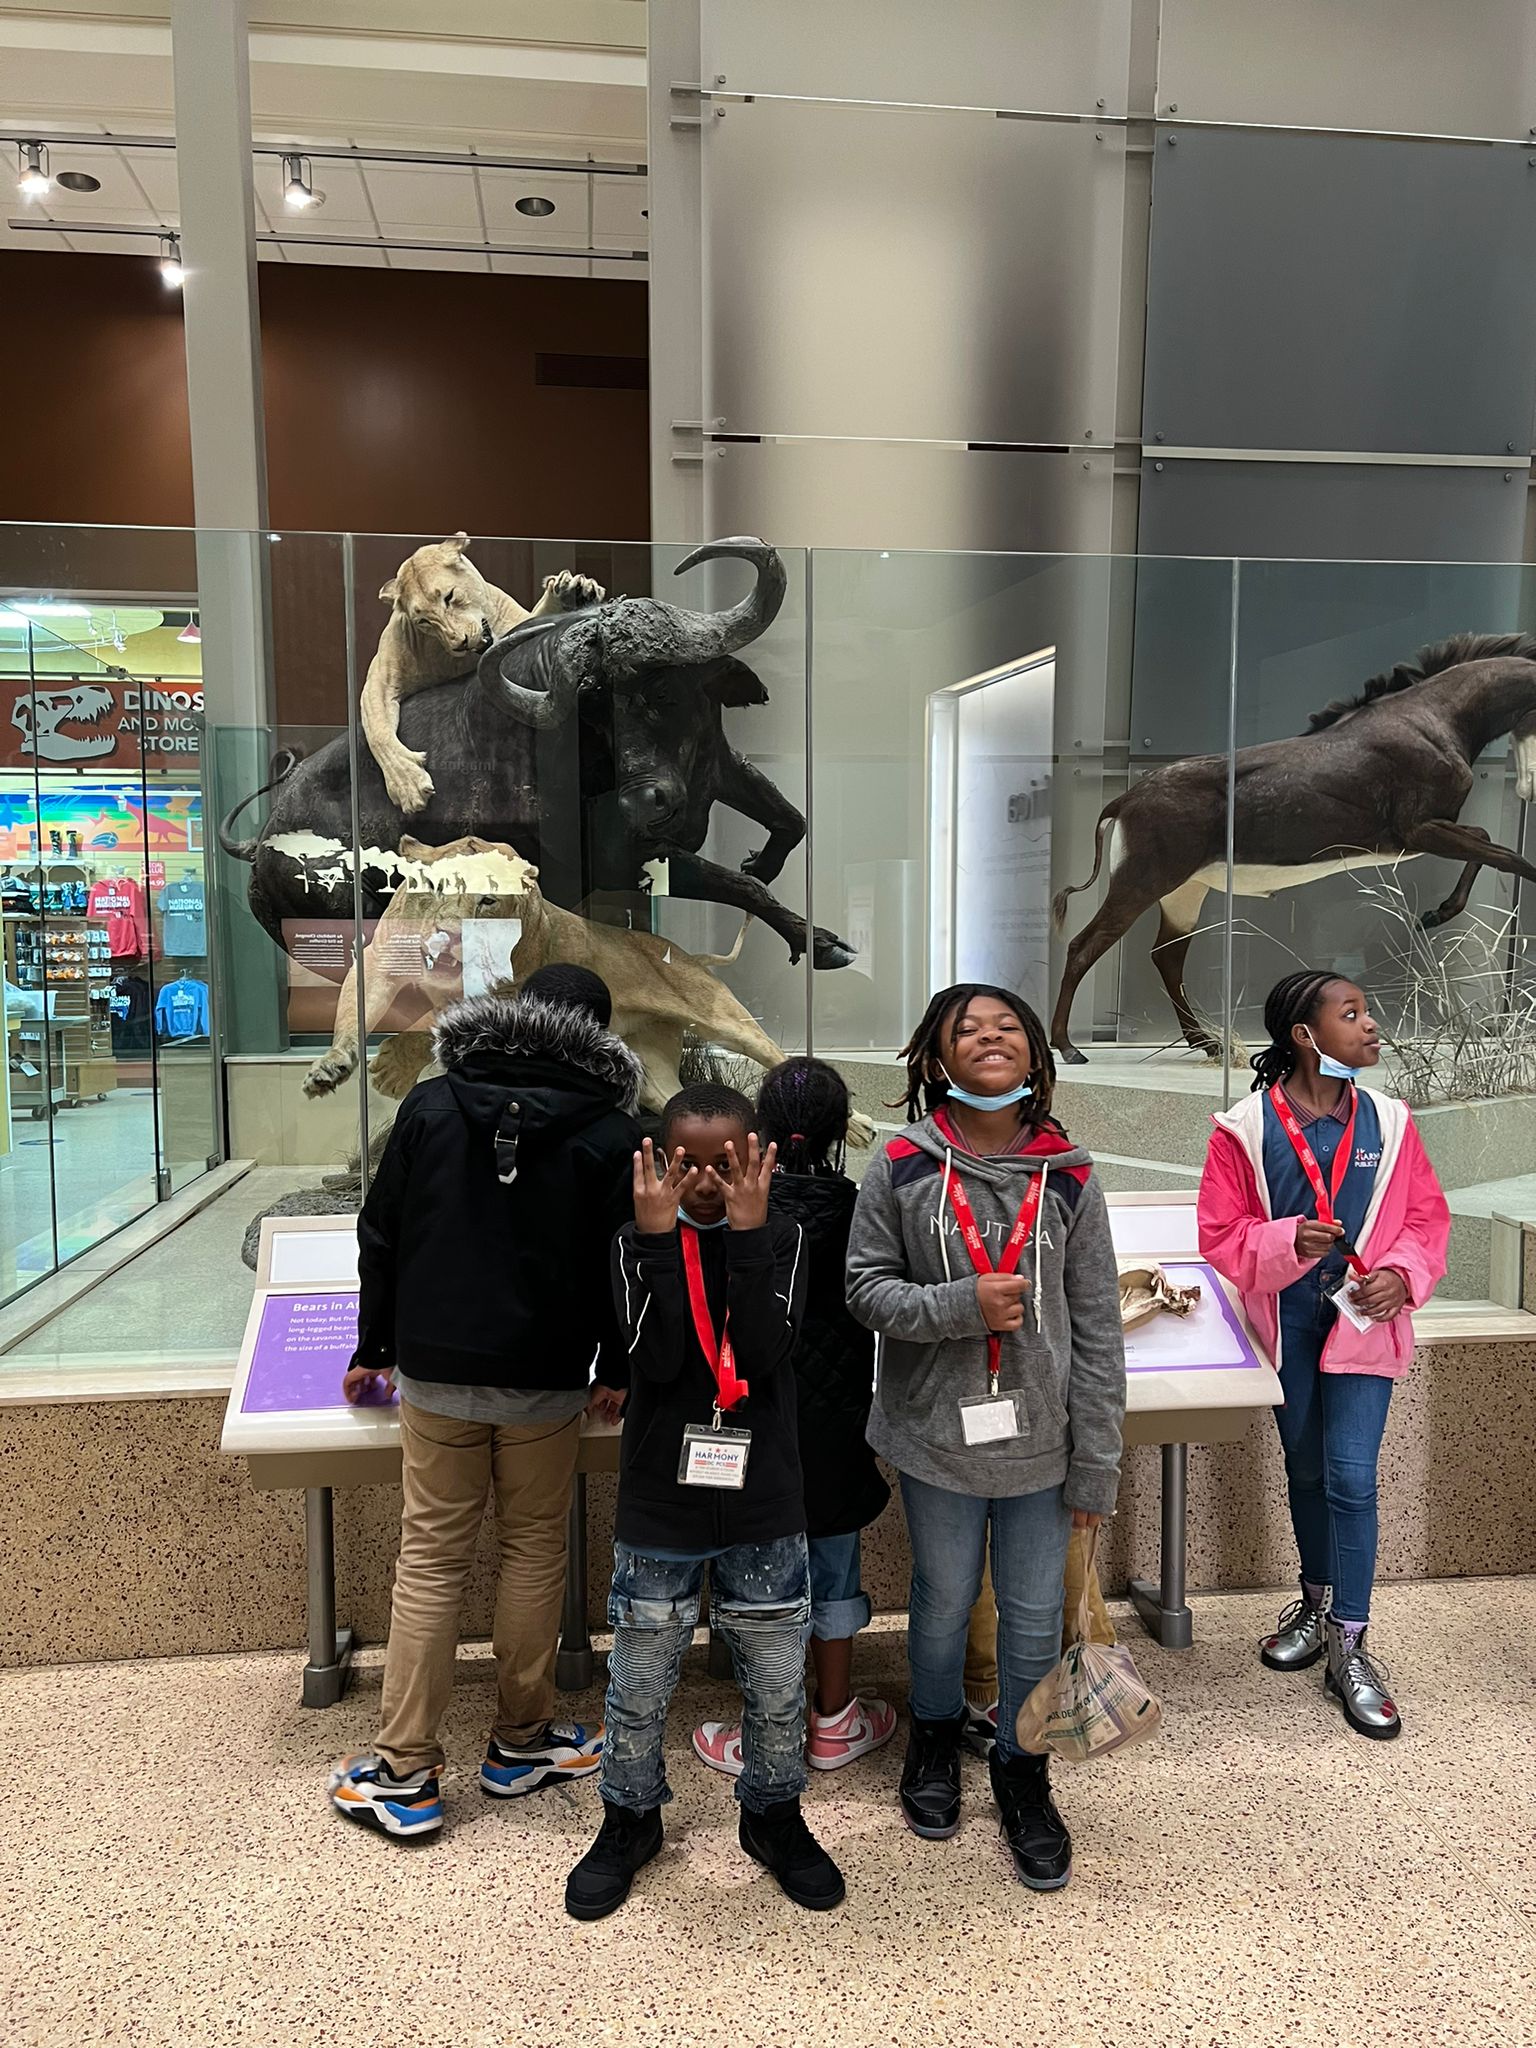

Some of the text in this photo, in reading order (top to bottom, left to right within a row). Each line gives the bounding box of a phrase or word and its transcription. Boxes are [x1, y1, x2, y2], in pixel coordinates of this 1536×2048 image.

[118, 717, 199, 731] AND MO
[137, 736, 199, 751] STORE
[293, 1303, 328, 1312] Bears
[331, 1301, 342, 1311] in
[288, 1325, 333, 1334] long-legged
[695, 1451, 739, 1462] HARMONY
